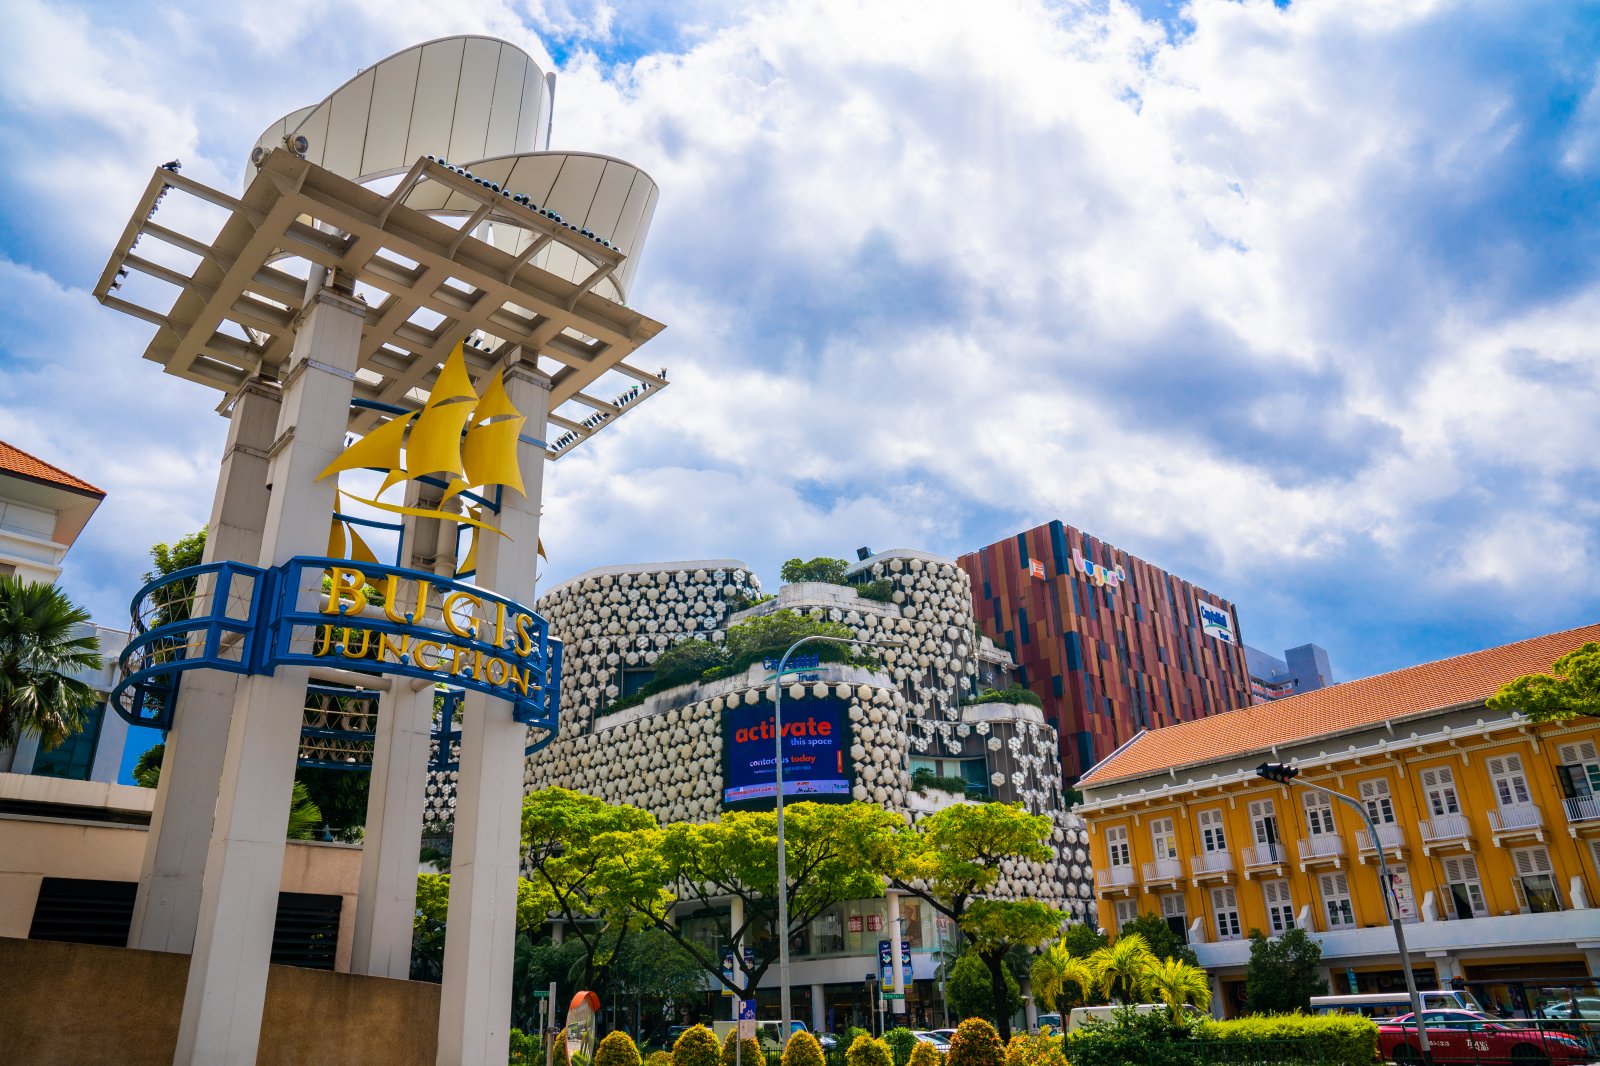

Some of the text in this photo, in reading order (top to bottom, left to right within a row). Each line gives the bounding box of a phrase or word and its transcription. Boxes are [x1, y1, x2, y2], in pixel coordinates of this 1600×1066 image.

[321, 566, 534, 658] BUGIS
[314, 624, 532, 697] JUNCTION
[796, 672, 819, 682] Trust
[735, 716, 832, 744] activate
[790, 737, 833, 748] this space
[749, 757, 777, 767] contact
[791, 754, 816, 764] today
[740, 1001, 746, 1013] P
